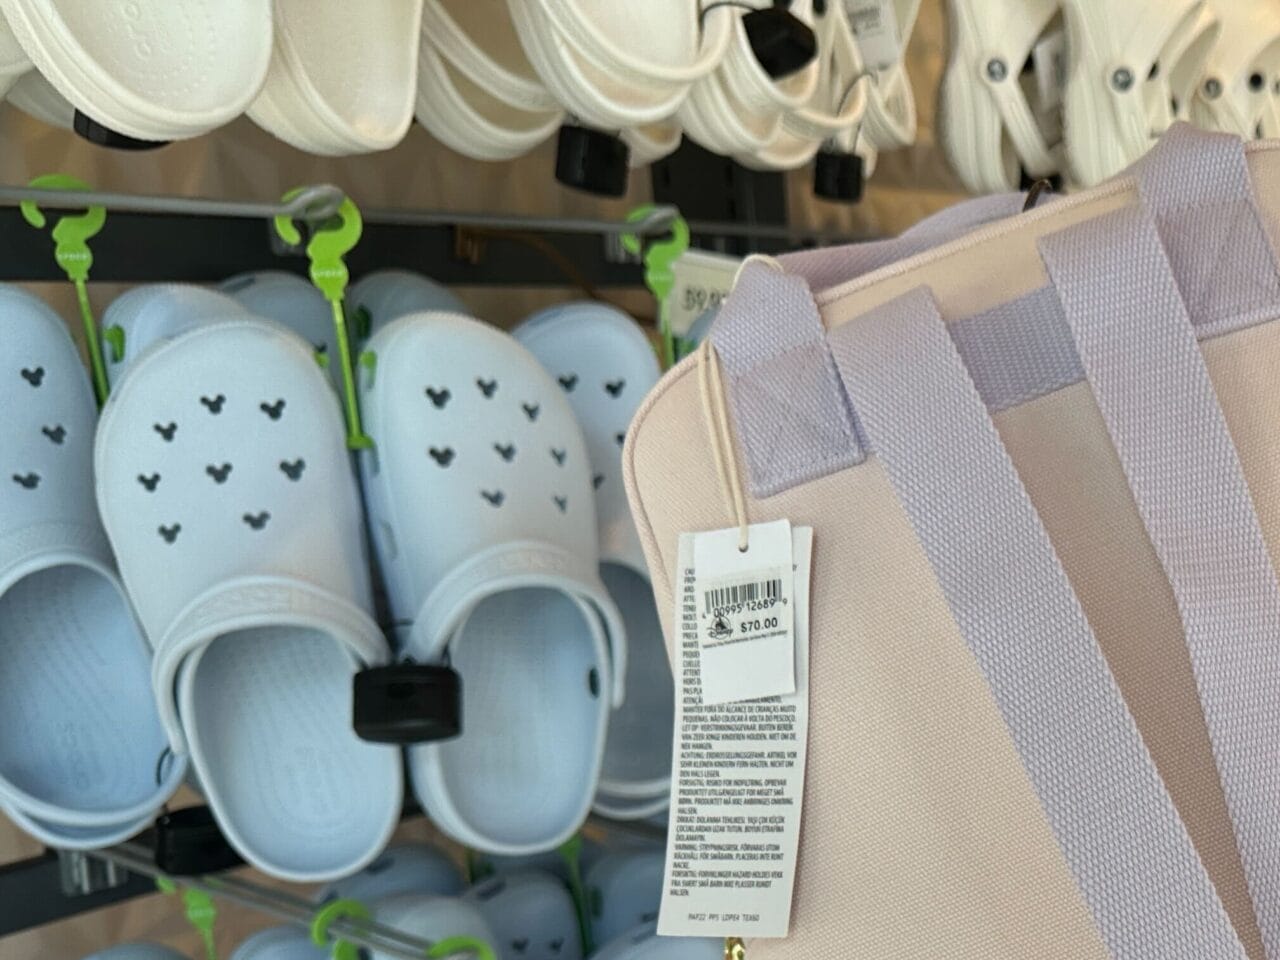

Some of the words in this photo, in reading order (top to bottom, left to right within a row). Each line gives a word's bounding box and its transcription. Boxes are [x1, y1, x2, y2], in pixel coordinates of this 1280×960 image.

[714, 603, 742, 618] 00995
[746, 598, 775, 612] 12689
[740, 617, 778, 633] $70.00
